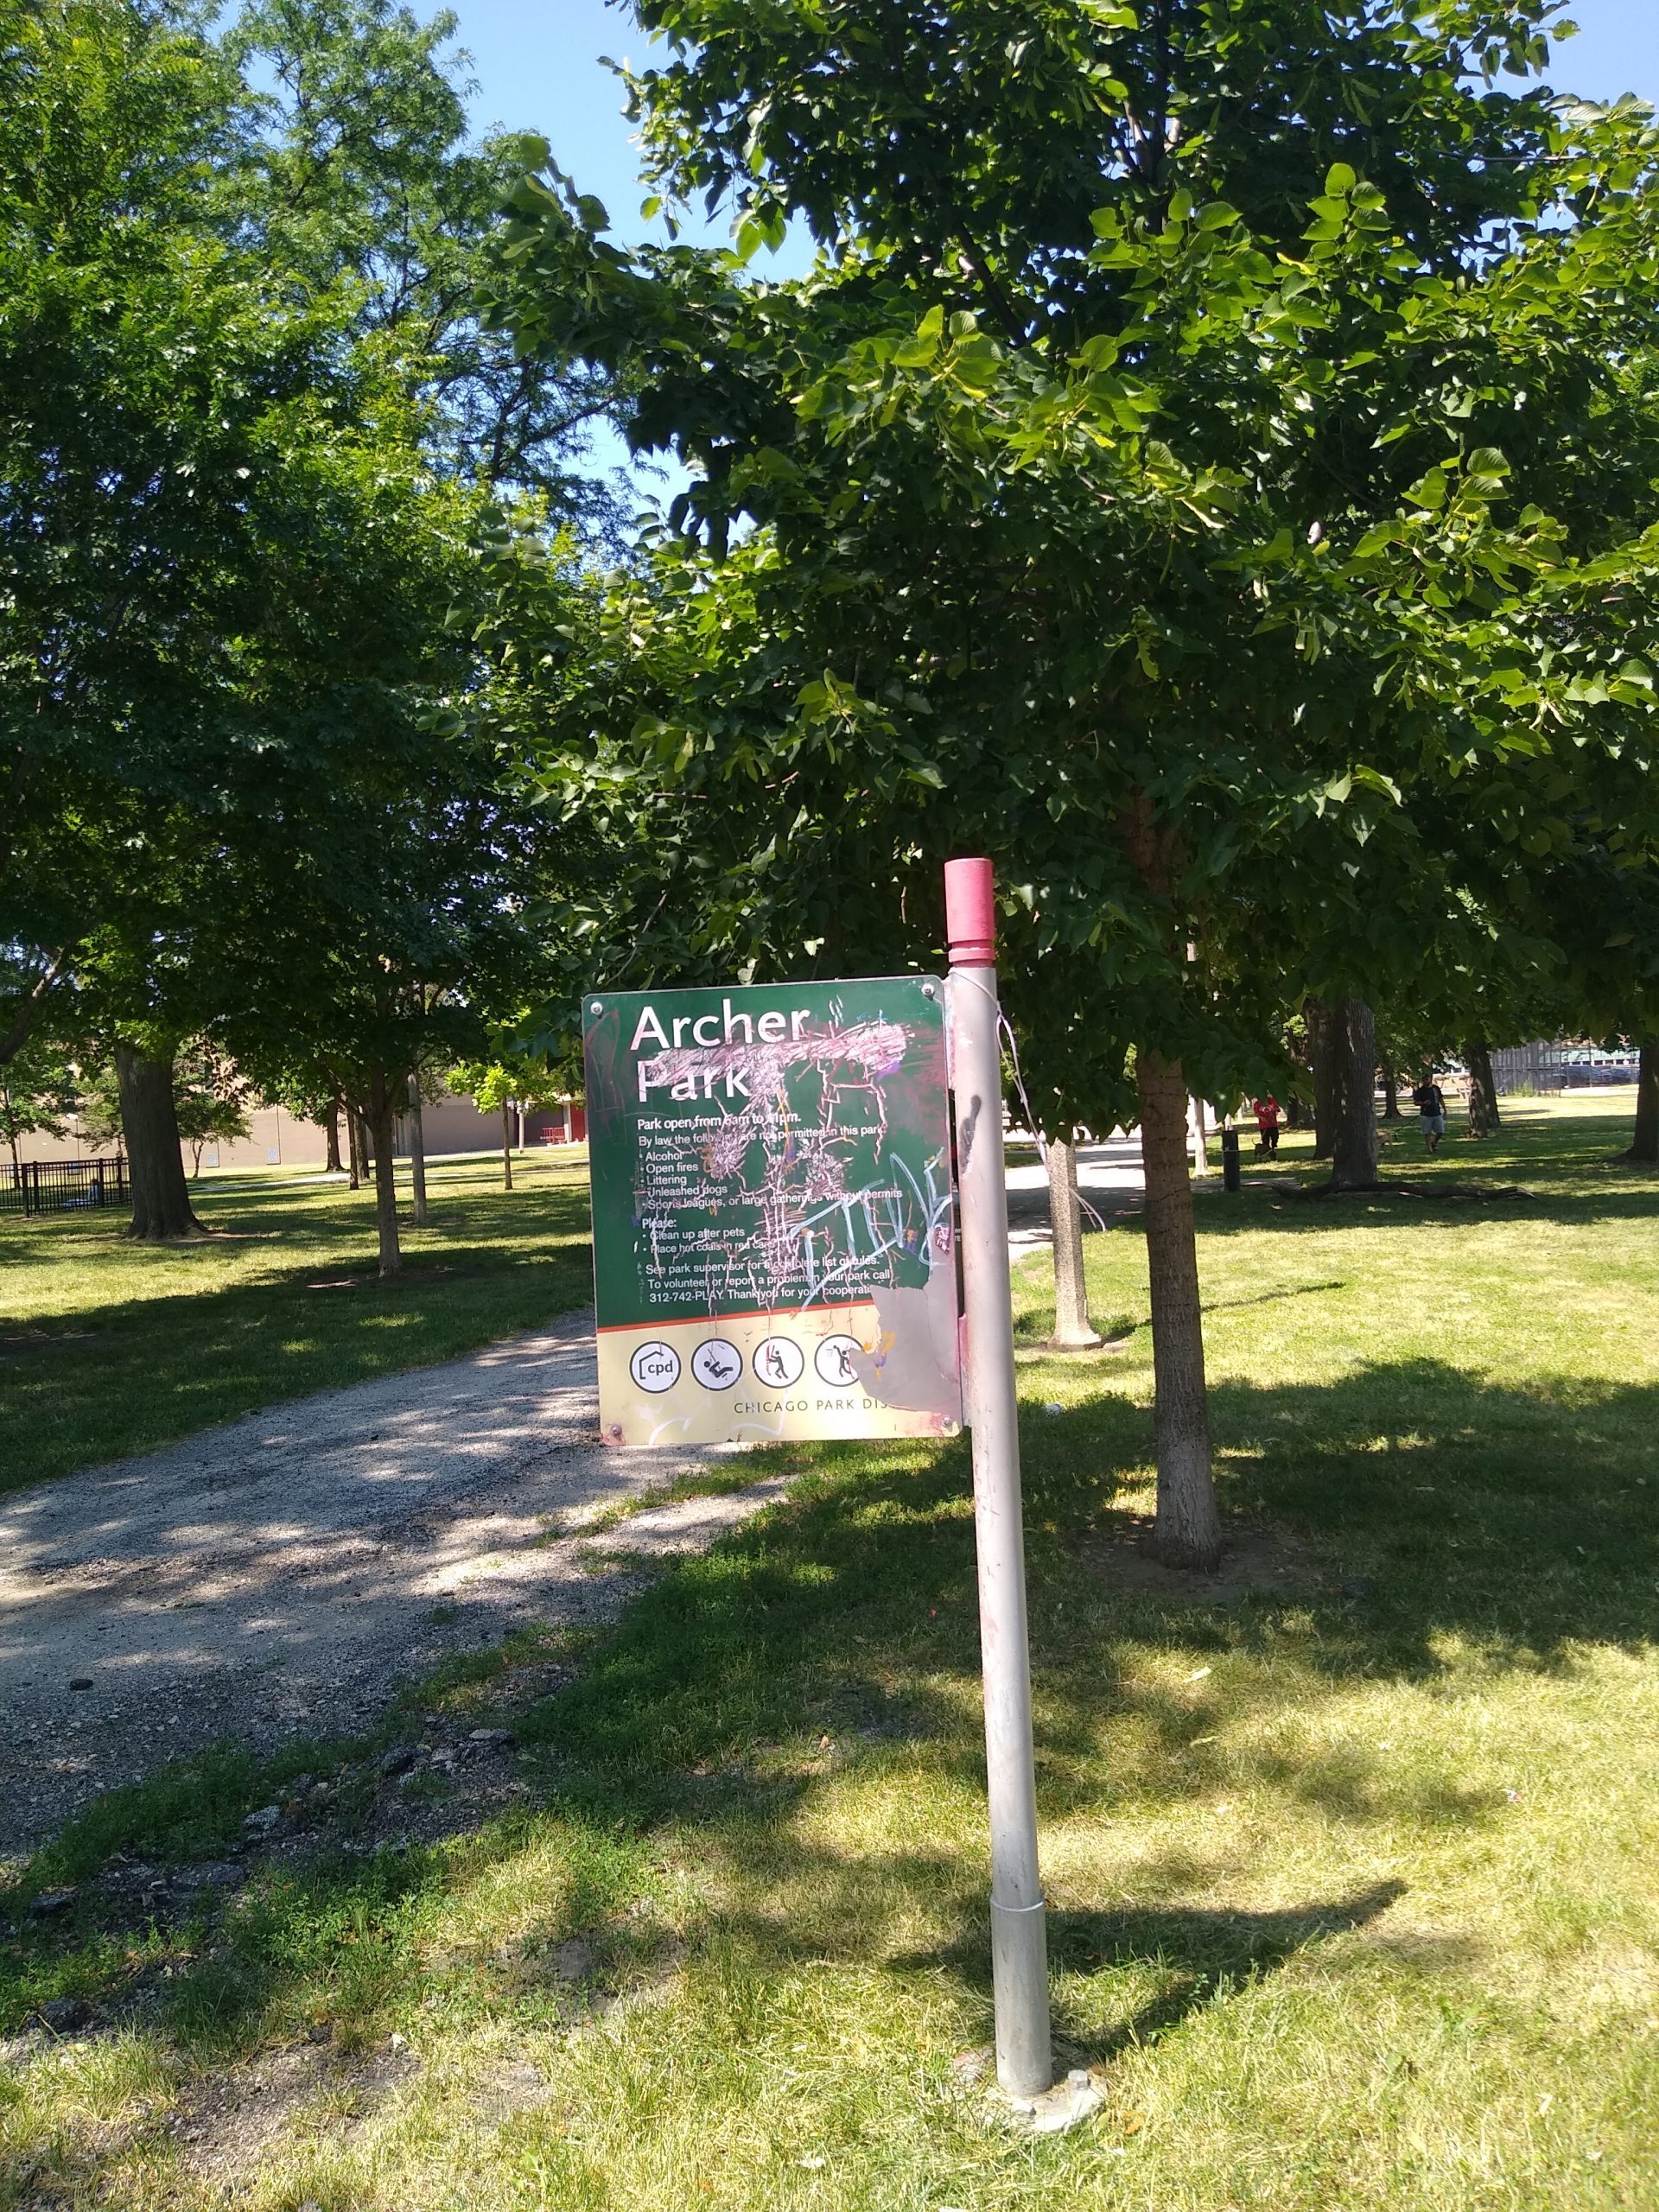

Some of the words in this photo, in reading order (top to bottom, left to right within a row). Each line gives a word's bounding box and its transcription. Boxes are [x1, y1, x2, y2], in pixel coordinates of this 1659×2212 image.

[630, 998, 810, 1051] Archer
[637, 1056, 750, 1103] Park
[638, 1118, 661, 1130] Park
[664, 1119, 691, 1132] open
[694, 1116, 721, 1127] from
[752, 1113, 764, 1123] to
[639, 1136, 652, 1148] By
[655, 1135, 672, 1146] law
[674, 1135, 690, 1144] the
[693, 1131, 739, 1144] follo
[760, 1130, 776, 1141] no
[778, 1127, 826, 1141] permitted
[840, 1125, 858, 1135] this
[645, 1151, 683, 1161] Alcohol
[646, 1163, 674, 1174] Open
[677, 1162, 698, 1172] fires
[646, 1175, 687, 1186] Littering
[648, 1185, 699, 1198] Unleashed
[702, 1184, 728, 1196] dogs
[742, 1193, 767, 1206] large
[865, 1188, 903, 1200] permits
[642, 1217, 677, 1229] Please:
[650, 1230, 679, 1240] Clean
[683, 1230, 695, 1241] up
[698, 1229, 720, 1238] after
[723, 1228, 745, 1239] pets
[651, 1243, 677, 1253] Place
[679, 1243, 694, 1253] hot
[735, 1240, 751, 1250] red
[645, 1264, 665, 1274] See
[669, 1262, 690, 1274] park
[693, 1260, 745, 1273] supervisor
[747, 1259, 762, 1269] for
[852, 1255, 880, 1266] ules.
[648, 1279, 661, 1289] To
[664, 1277, 709, 1288] volunteer
[725, 1275, 754, 1287] report
[767, 1273, 805, 1286] problem
[849, 1271, 870, 1282] park
[873, 1269, 890, 1280] call
[650, 1289, 724, 1302] 312-742-PLAY.
[728, 1287, 757, 1300] Thank
[760, 1287, 778, 1300] you
[781, 1287, 795, 1297] for
[798, 1287, 819, 1299] your
[823, 1283, 871, 1297] cooperati
[647, 1360, 673, 1376] cpd
[734, 1400, 808, 1414] CHICAGO
[817, 1397, 854, 1410] PARK
